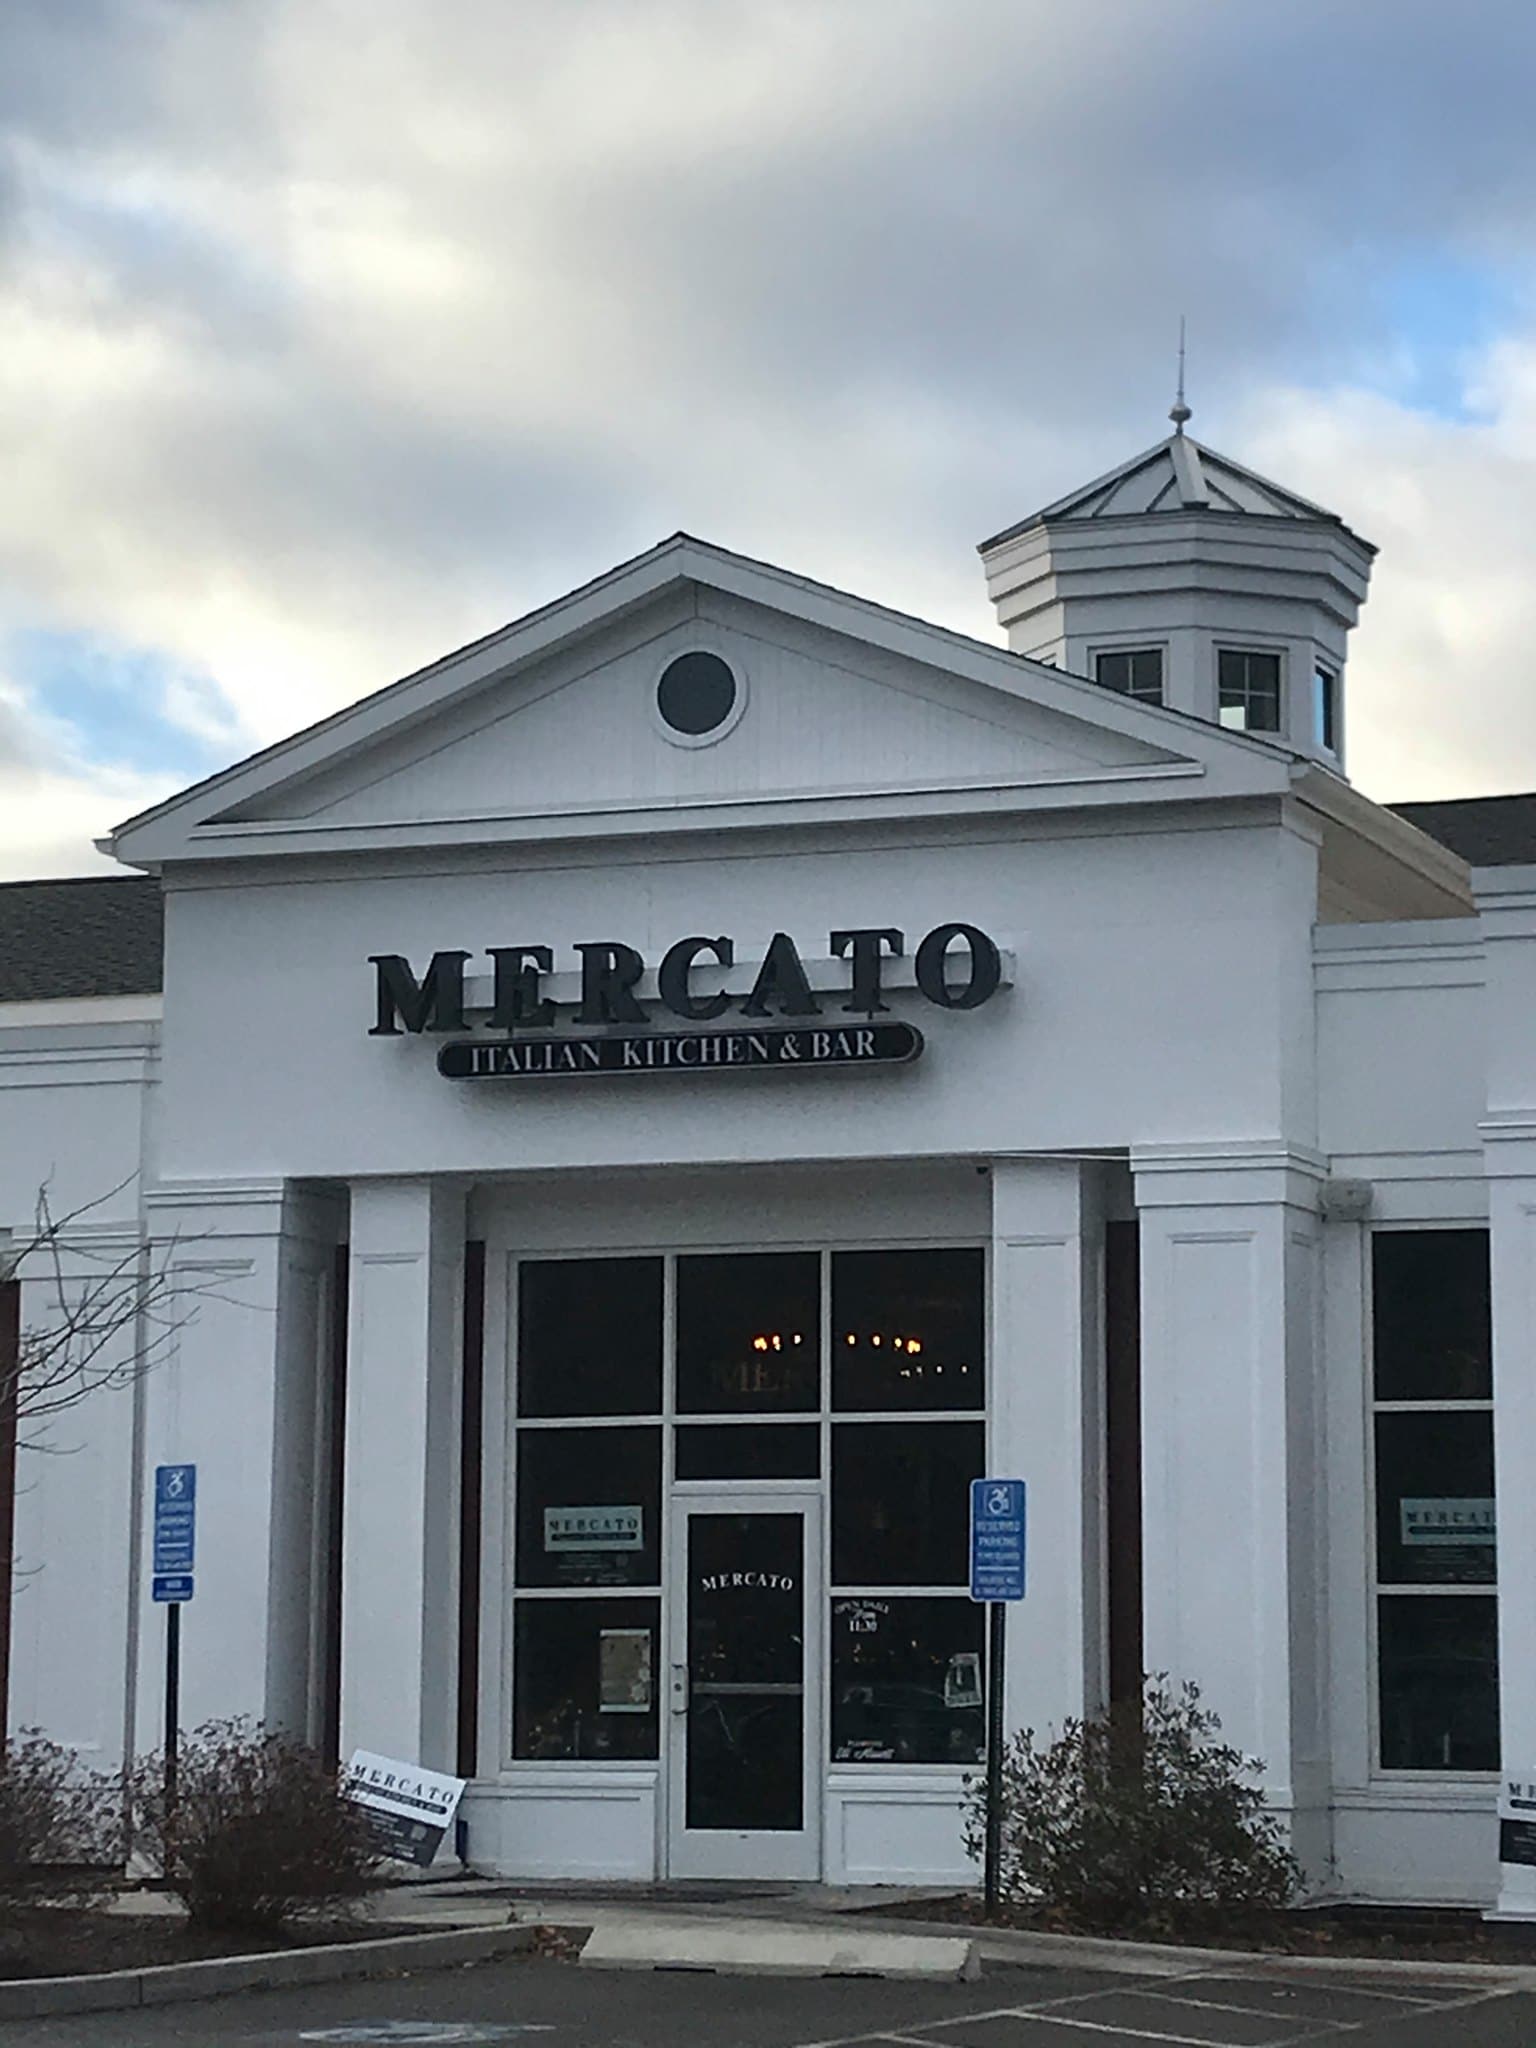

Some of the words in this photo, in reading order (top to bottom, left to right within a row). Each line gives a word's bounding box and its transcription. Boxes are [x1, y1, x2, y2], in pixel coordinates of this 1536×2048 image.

[368, 923, 1001, 1037] MERCATO
[470, 1042, 600, 1074] ITALIAN
[622, 1035, 769, 1067] KITCHEN
[779, 1034, 799, 1060] &
[812, 1029, 876, 1060] BAR
[548, 1518, 639, 1531] MERCATO
[702, 1572, 794, 1592] MERCATO
[351, 1764, 455, 1805] MERCATO
